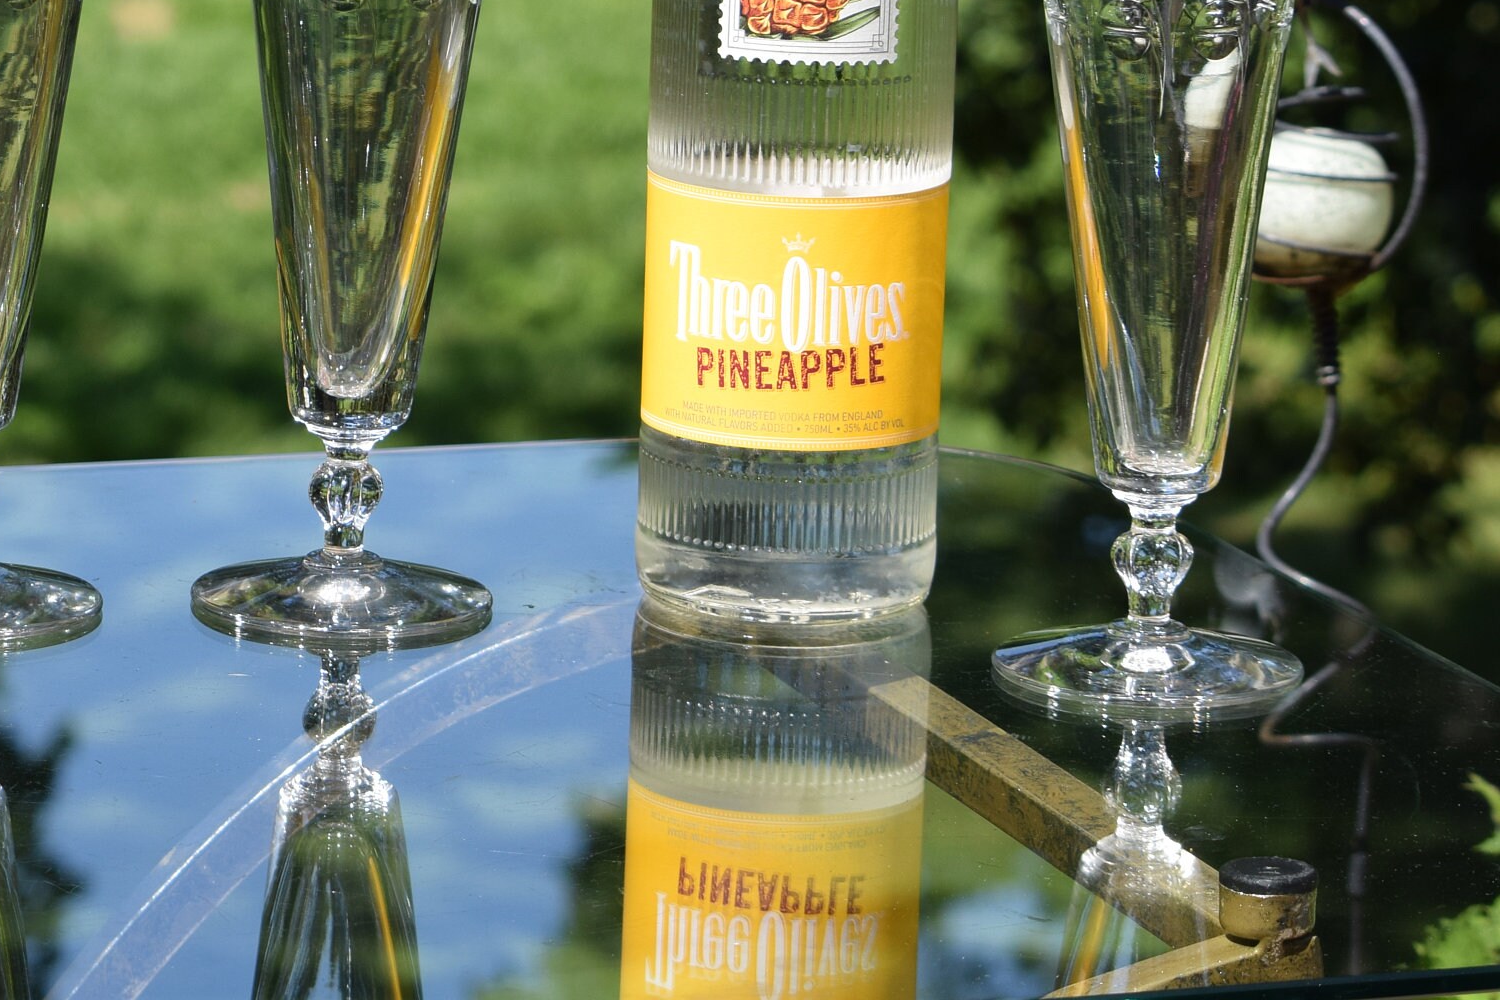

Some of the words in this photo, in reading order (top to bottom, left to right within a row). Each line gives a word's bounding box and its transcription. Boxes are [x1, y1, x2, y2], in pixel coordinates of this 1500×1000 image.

[669, 238, 776, 345] Three
[780, 255, 907, 353] Olives
[696, 341, 885, 391] PINEAPPLE
[665, 408, 681, 419] WITH
[682, 411, 717, 427] NATURAL
[719, 418, 757, 432] FLAVORS
[761, 423, 794, 433] ADDED
[804, 424, 834, 434] 750ML
[843, 423, 862, 433] 35%
[863, 421, 879, 432] ALC
[880, 419, 891, 431] BY
[891, 417, 906, 429] VOL
[683, 400, 704, 413] MADE
[706, 404, 727, 417] WITH
[730, 407, 777, 421] IMPORTED
[779, 411, 810, 423] VODKA
[813, 411, 840, 423] FROM
[842, 409, 884, 422] ENGLAND
